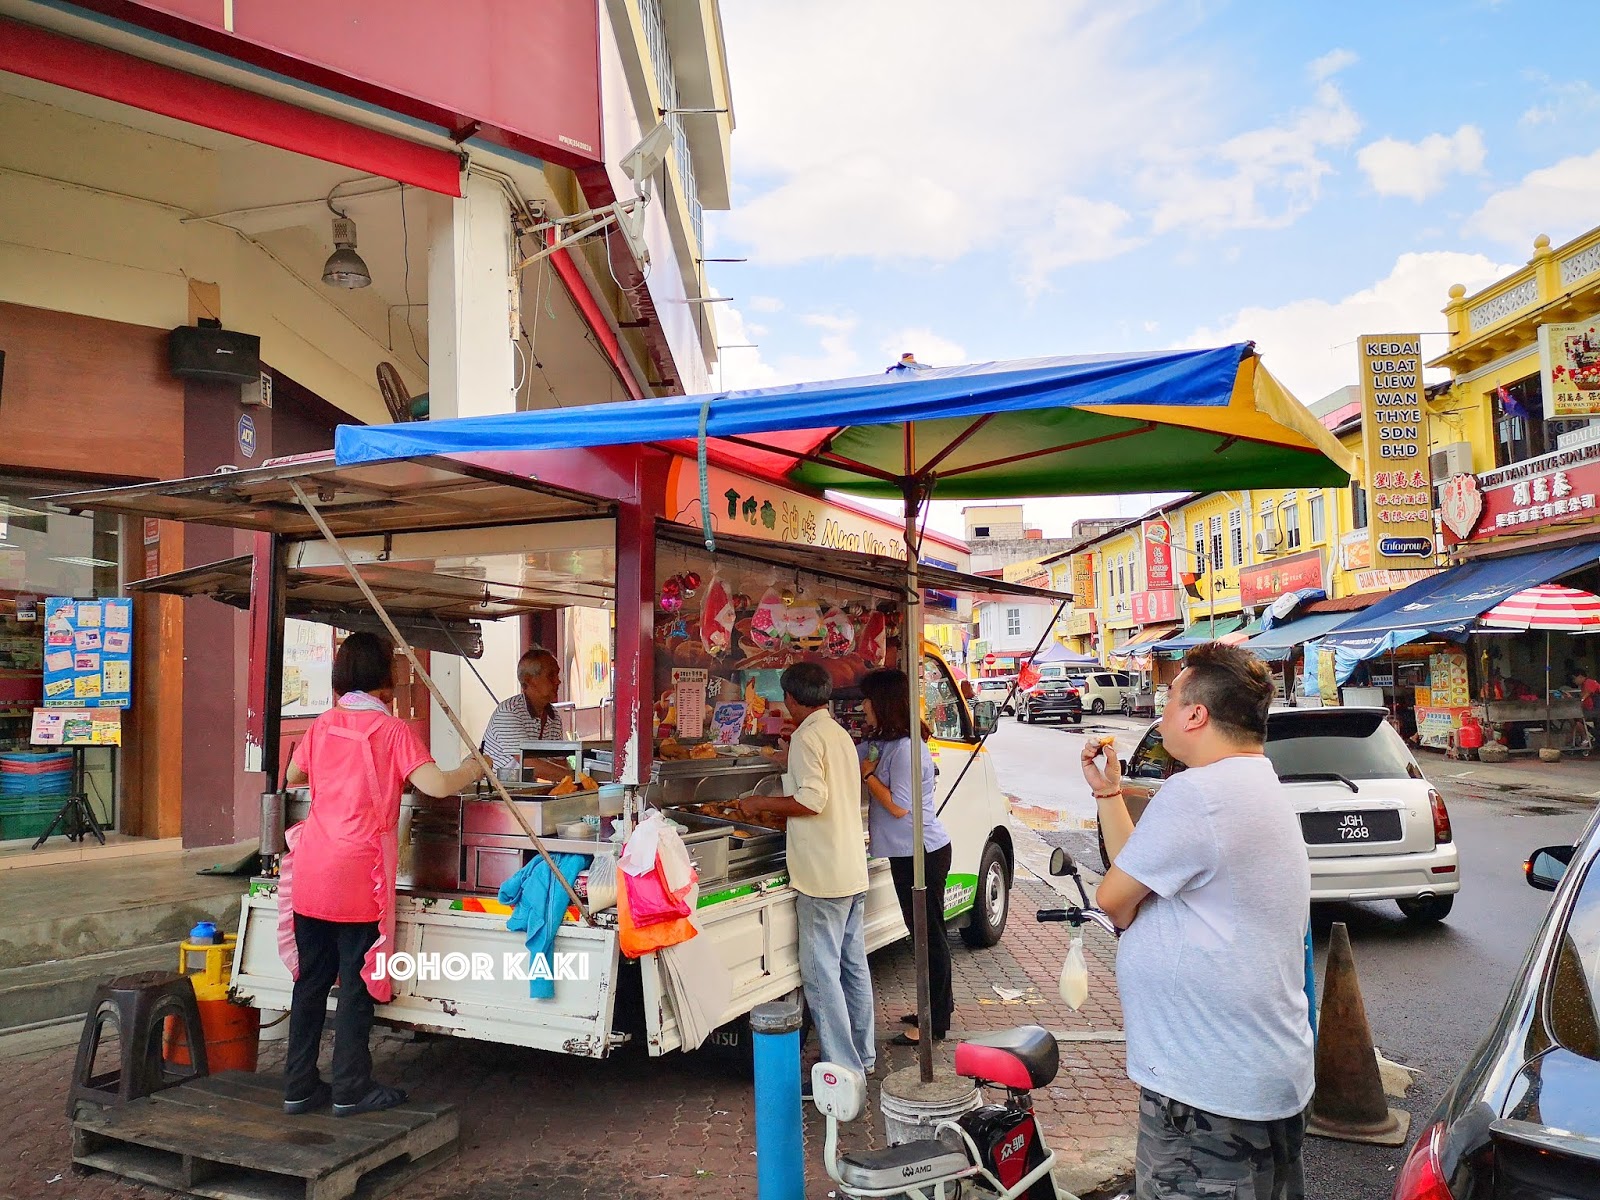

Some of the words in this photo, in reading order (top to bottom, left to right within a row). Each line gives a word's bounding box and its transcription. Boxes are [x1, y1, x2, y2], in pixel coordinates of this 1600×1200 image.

[1367, 342, 1420, 355] KEDAI
[1372, 360, 1416, 372] UBAT
[1375, 376, 1415, 388] LIEW
[1376, 393, 1417, 405] WAN
[1376, 410, 1420, 422] THYE
[241, 428, 253, 445] ADT
[1380, 427, 1417, 439] SDN
[1559, 430, 1587, 447] KEDAI
[1381, 444, 1417, 457] BHD
[1480, 472, 1503, 487] LIEW
[1506, 464, 1529, 480] WAN
[1529, 456, 1559, 474] THYE
[1374, 469, 1428, 489] 劉萬泰
[1378, 509, 1428, 523] 有限公司
[1381, 540, 1420, 553] Enfagrow
[1375, 570, 1387, 586] KEE
[1387, 569, 1406, 584] KEDAI
[1340, 815, 1363, 827] JGH
[1337, 827, 1370, 839] 7268
